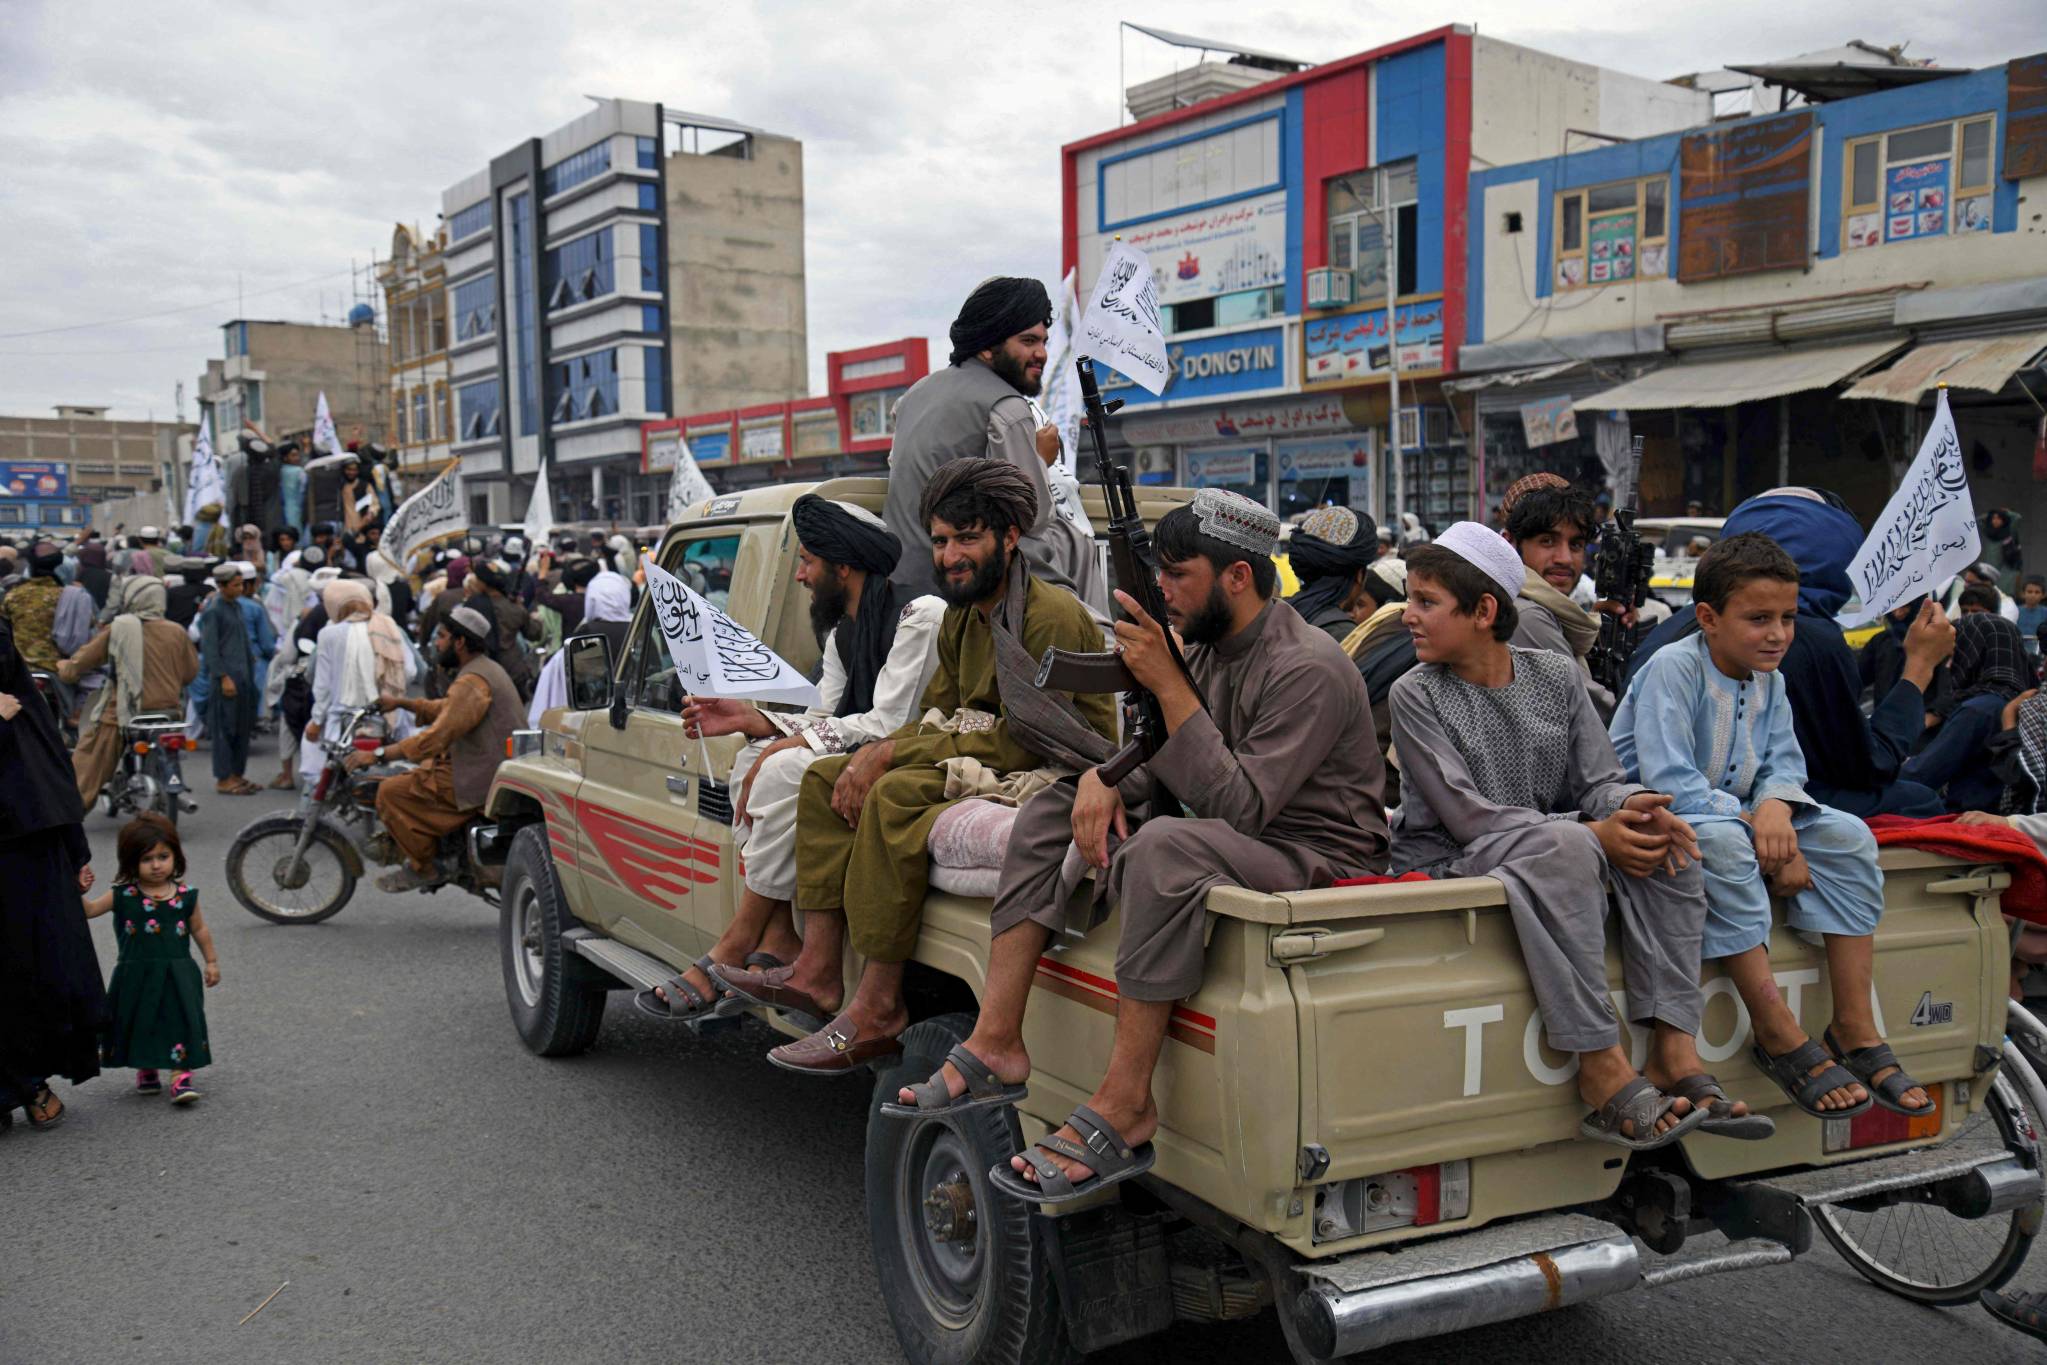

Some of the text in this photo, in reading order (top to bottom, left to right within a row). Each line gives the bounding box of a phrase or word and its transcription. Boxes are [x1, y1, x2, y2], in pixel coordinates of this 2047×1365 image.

[1184, 345, 1275, 379] DONGYIN
[1911, 991, 1953, 1026] 4WD
[1444, 968, 1887, 1097] TOYOT
